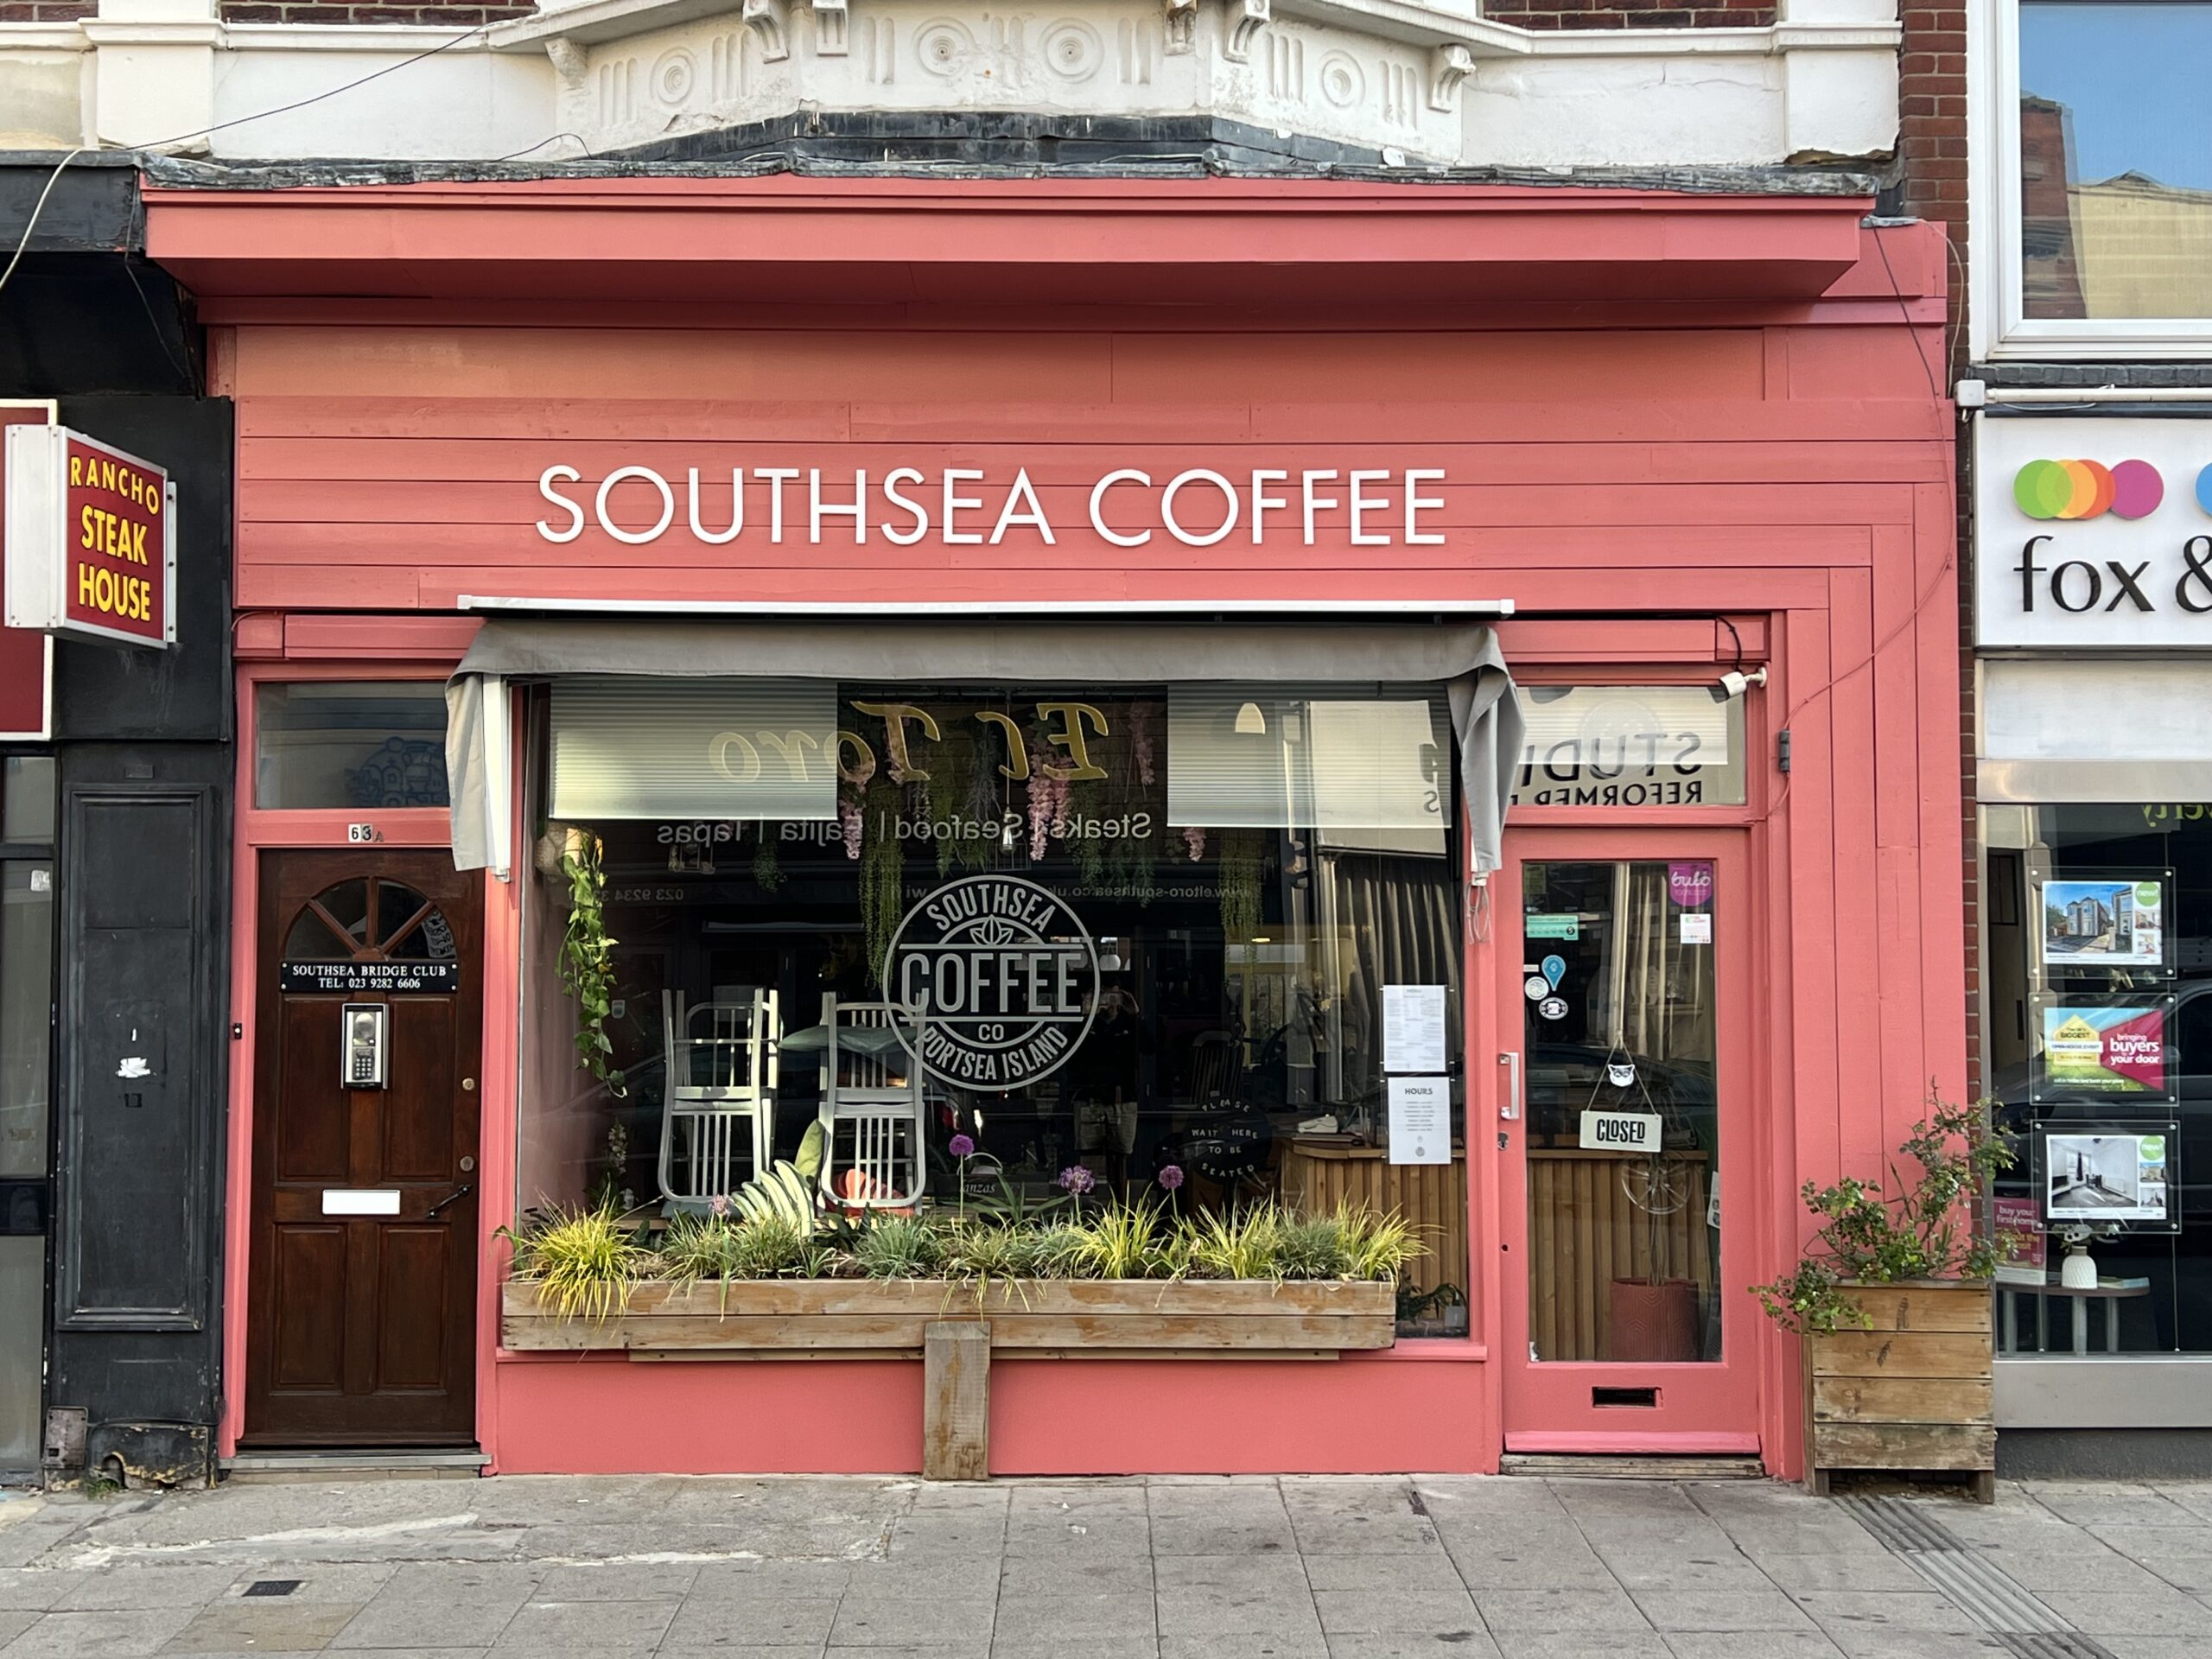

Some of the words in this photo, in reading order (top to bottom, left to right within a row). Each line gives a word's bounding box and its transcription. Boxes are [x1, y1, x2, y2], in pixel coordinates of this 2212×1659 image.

[70, 456, 159, 515] RANCHO
[535, 464, 1056, 546] SOUTHSEA
[1089, 468, 1446, 547] COFFEE
[81, 504, 148, 566] STEAK
[2013, 535, 2156, 613] fox
[79, 562, 150, 622] HOUSE
[926, 883, 1056, 933] SOUTHSEA
[292, 965, 355, 976] SOUTHSEA
[361, 966, 408, 976] BRIDGE
[413, 966, 446, 976] CLUB
[901, 952, 1081, 1013] COFFEE
[348, 978, 365, 988] 023
[371, 978, 392, 988] 9282
[397, 978, 420, 988] 6606
[978, 1024, 1004, 1041] CO
[914, 1026, 996, 1080] PORTSEA
[1001, 1027, 1068, 1078] ISLAND
[2110, 1038, 2159, 1055] buyers
[2110, 1056, 2133, 1066] your
[2135, 1053, 2160, 1064] door
[1192, 1128, 1217, 1137] WAIT
[1231, 1128, 1258, 1139] HERE
[1597, 1119, 1645, 1143] CLOSED
[1201, 1163, 1254, 1177] SEATED
[1999, 1205, 2015, 1217] buy
